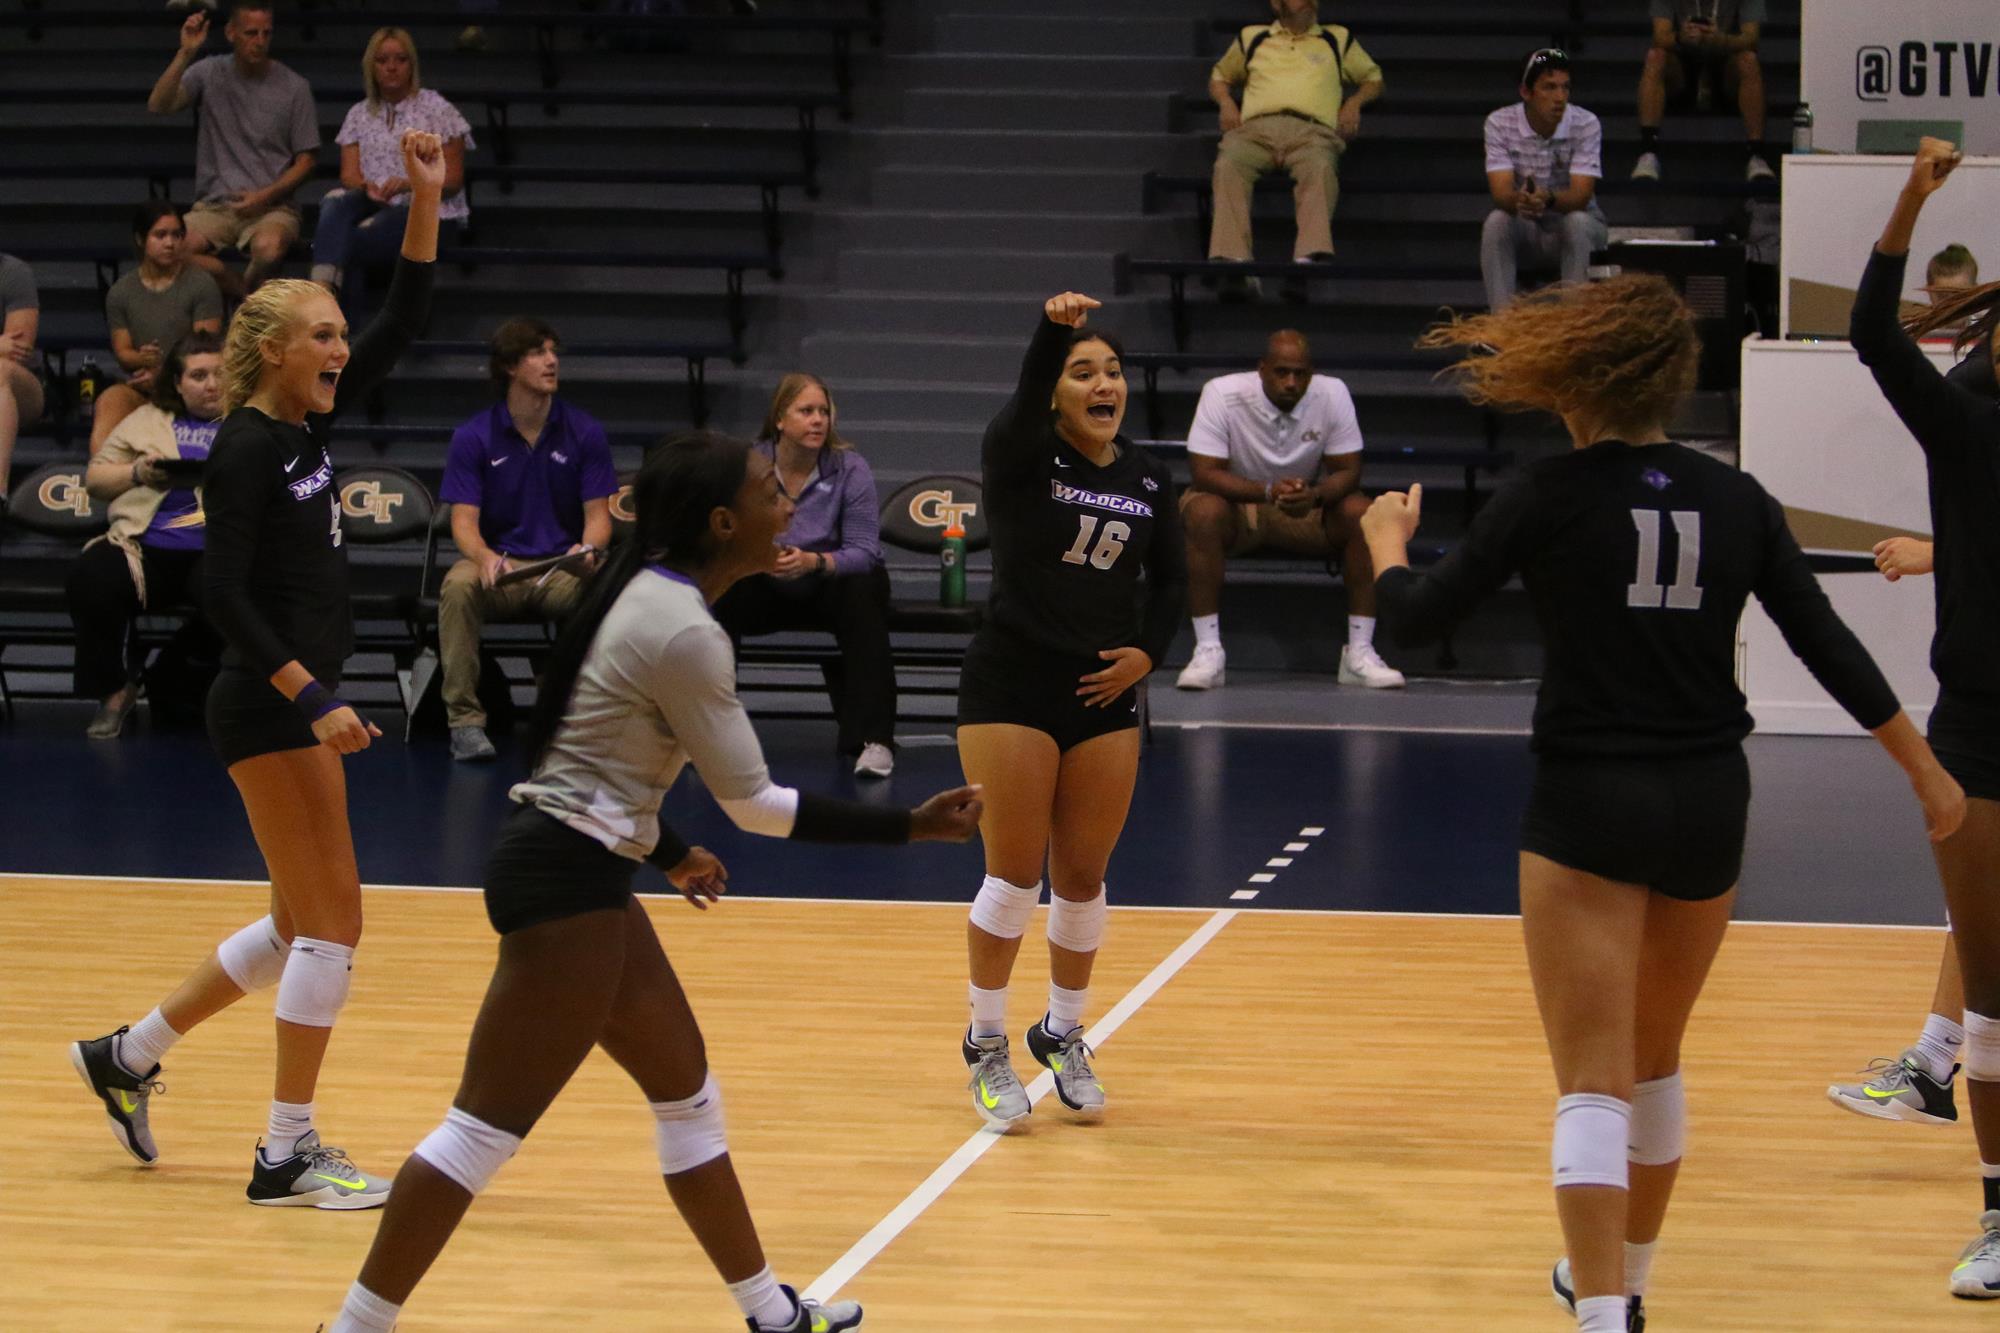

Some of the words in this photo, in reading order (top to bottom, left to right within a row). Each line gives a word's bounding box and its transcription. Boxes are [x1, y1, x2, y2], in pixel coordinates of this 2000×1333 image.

[1856, 41, 2000, 102] @GTV
[1055, 483, 1152, 517] WILDCATS
[1062, 514, 1131, 570] 16
[1627, 508, 1704, 610] 11
